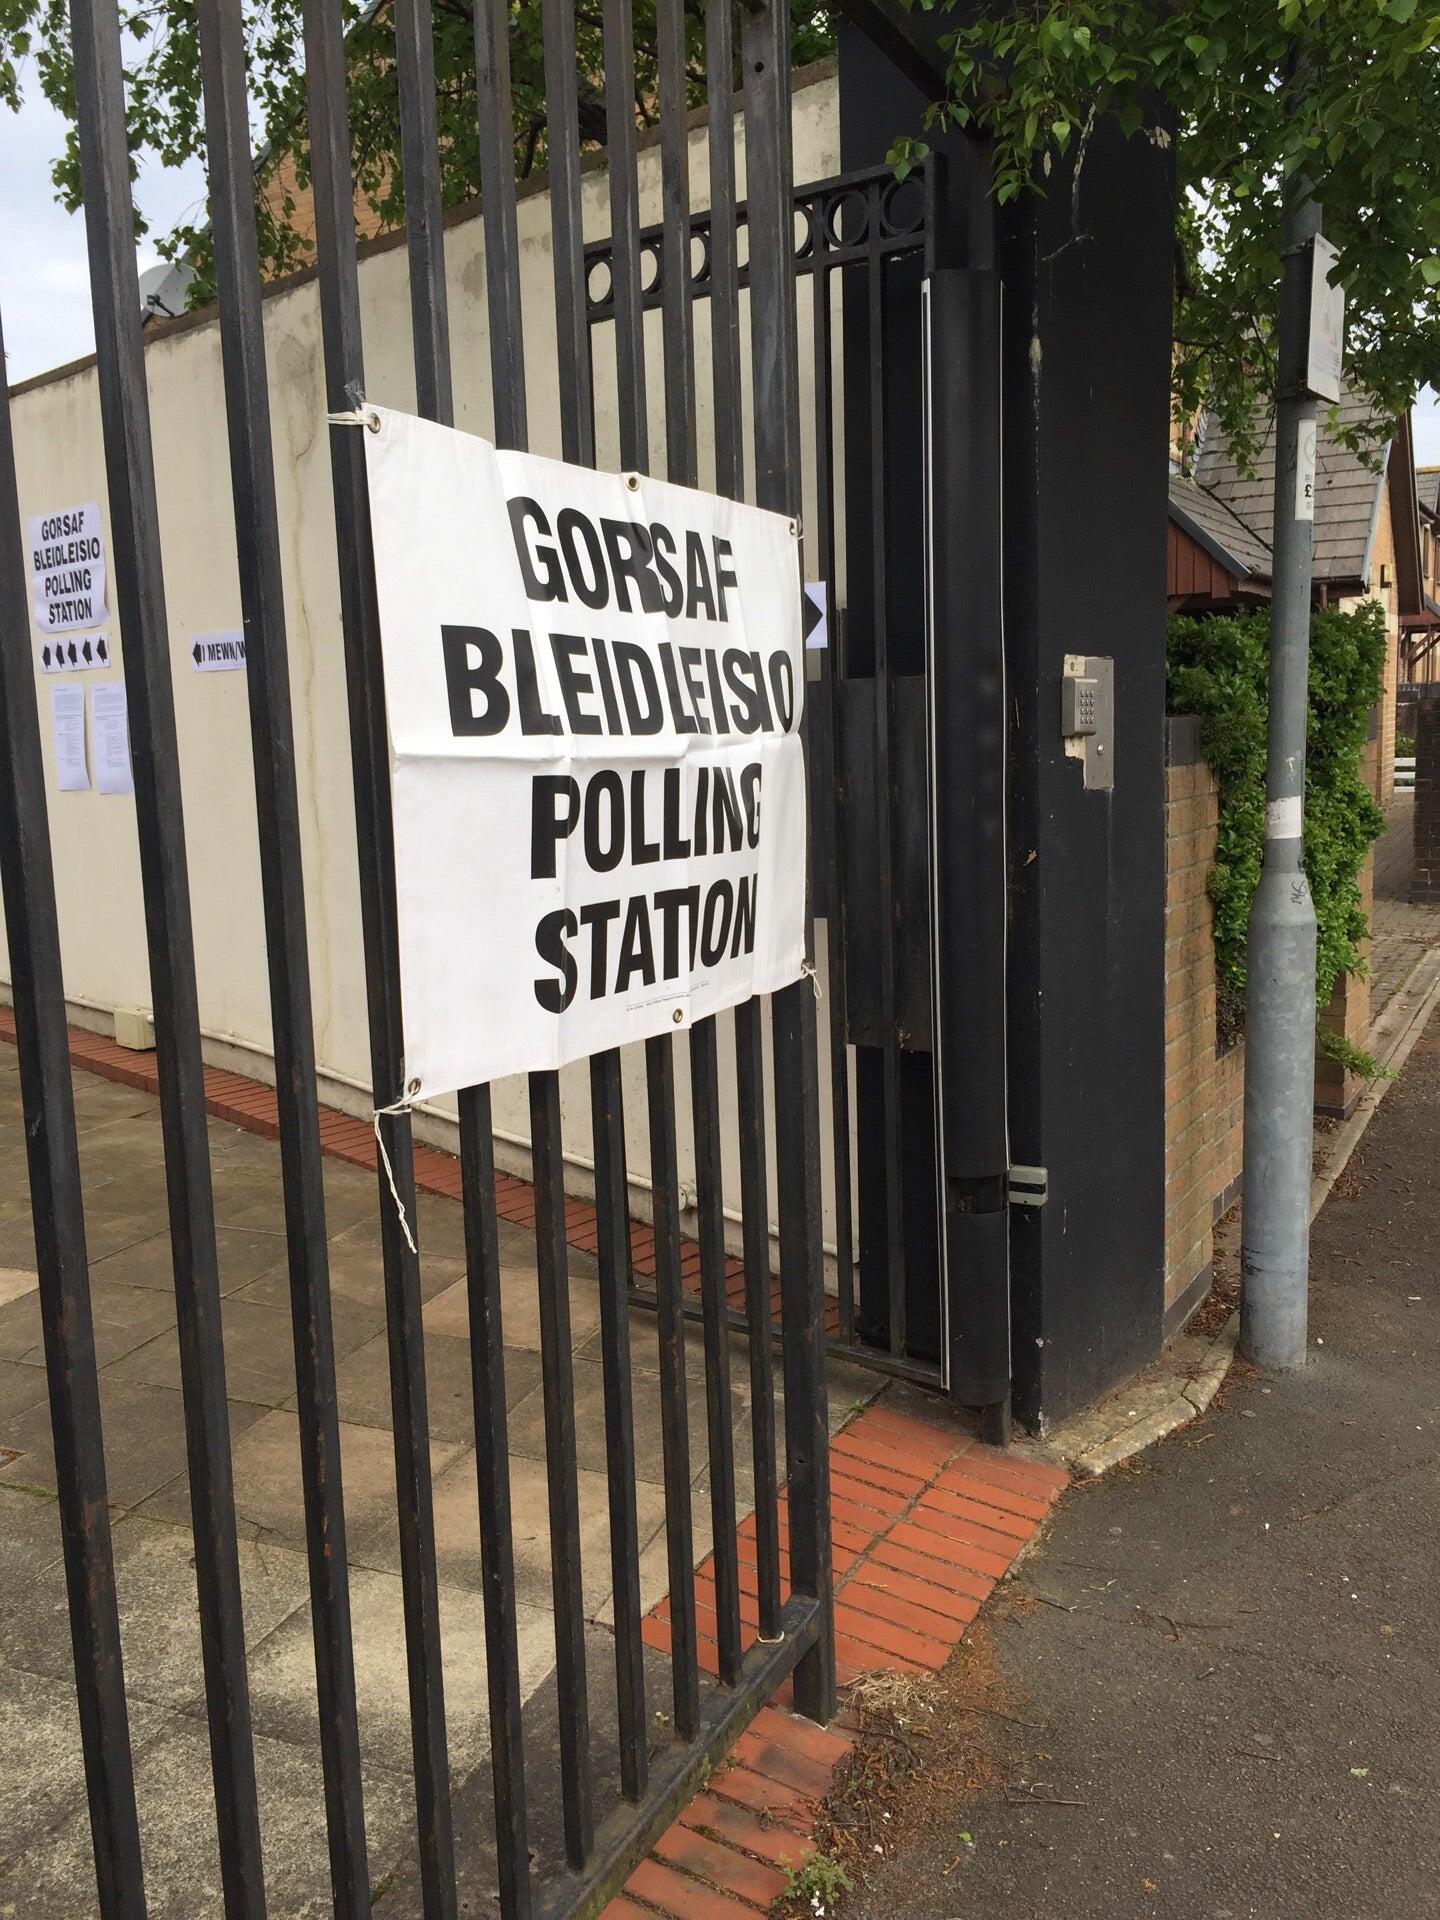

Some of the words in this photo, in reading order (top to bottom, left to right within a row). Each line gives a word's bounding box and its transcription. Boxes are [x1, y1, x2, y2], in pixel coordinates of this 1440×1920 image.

[33, 537, 100, 571] BLEIDLEISIO
[41, 511, 84, 541] GORSAF
[506, 496, 739, 622] GORSAF
[45, 568, 92, 597] POLLING
[48, 597, 93, 625] STATION
[441, 624, 794, 737] BLEIDLEISIO
[530, 762, 762, 880] POLLING
[534, 873, 758, 1015] STATION
